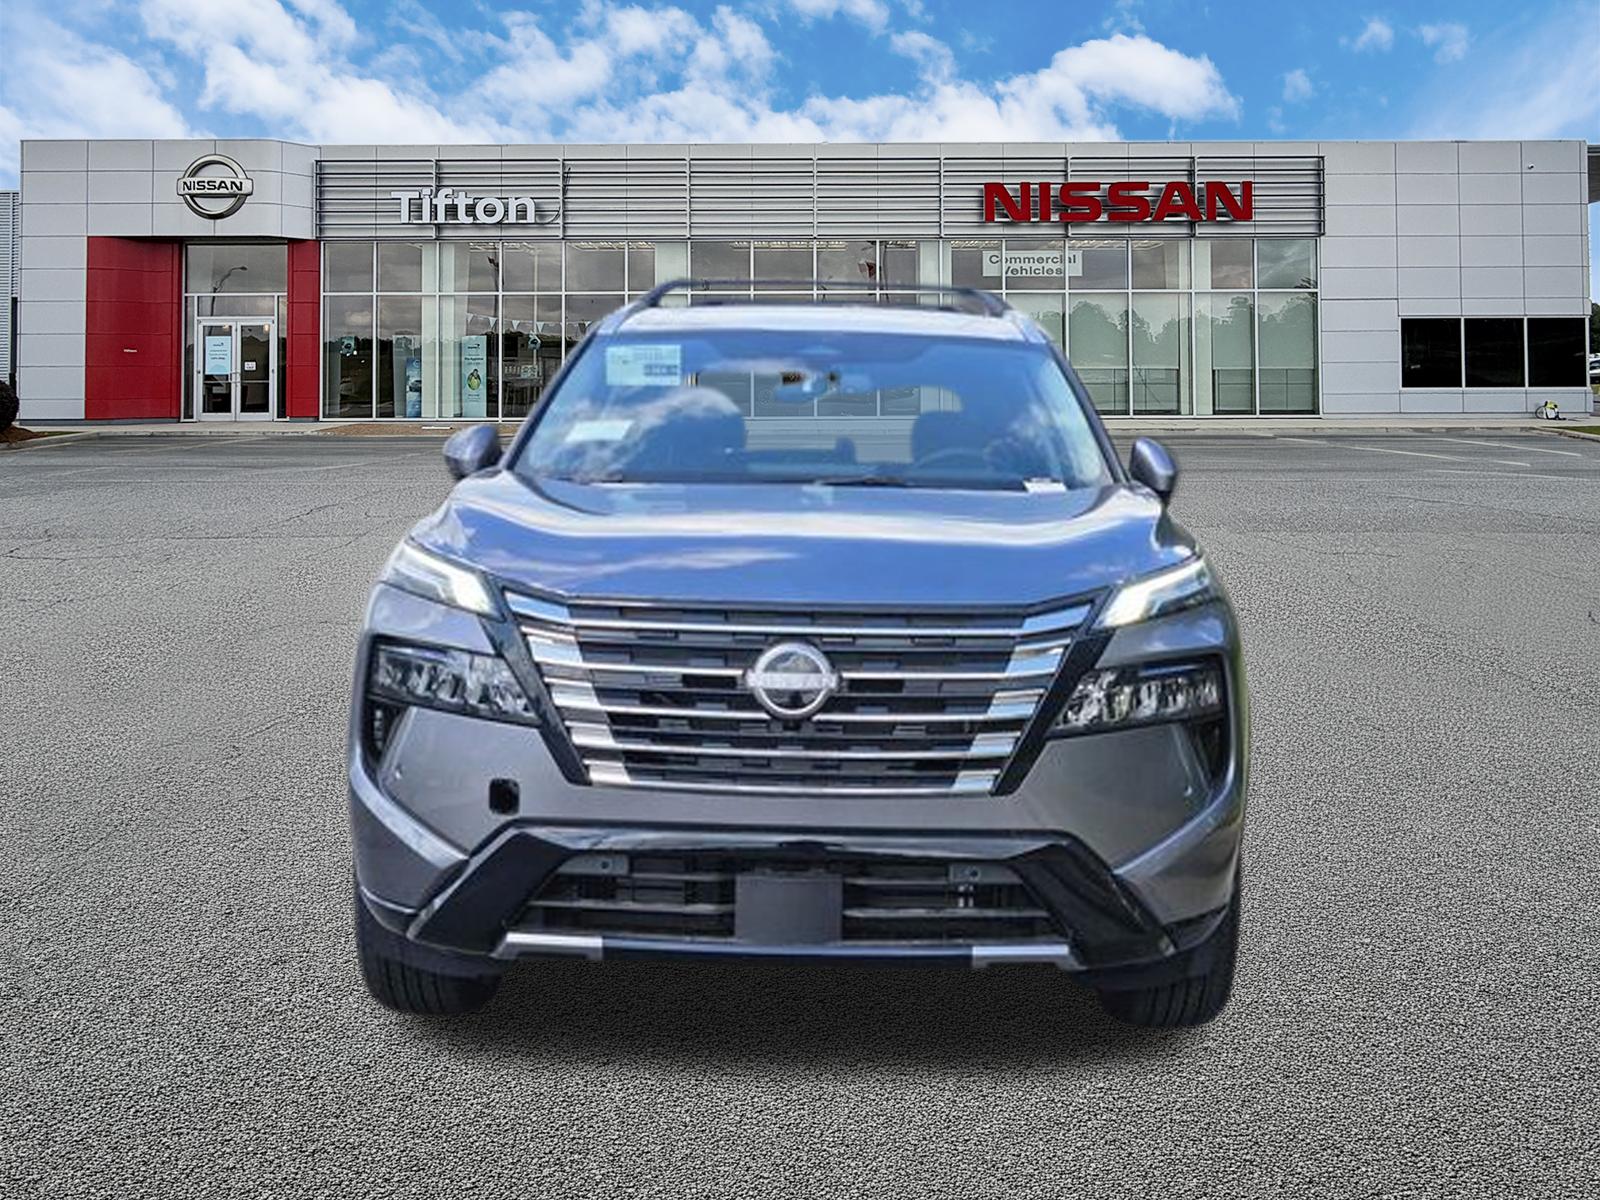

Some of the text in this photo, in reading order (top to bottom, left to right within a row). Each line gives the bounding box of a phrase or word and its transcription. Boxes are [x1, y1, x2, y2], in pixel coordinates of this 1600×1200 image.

[183, 181, 243, 191] NISSAN
[984, 181, 1253, 222] NISSAN
[391, 188, 536, 223] Tifton
